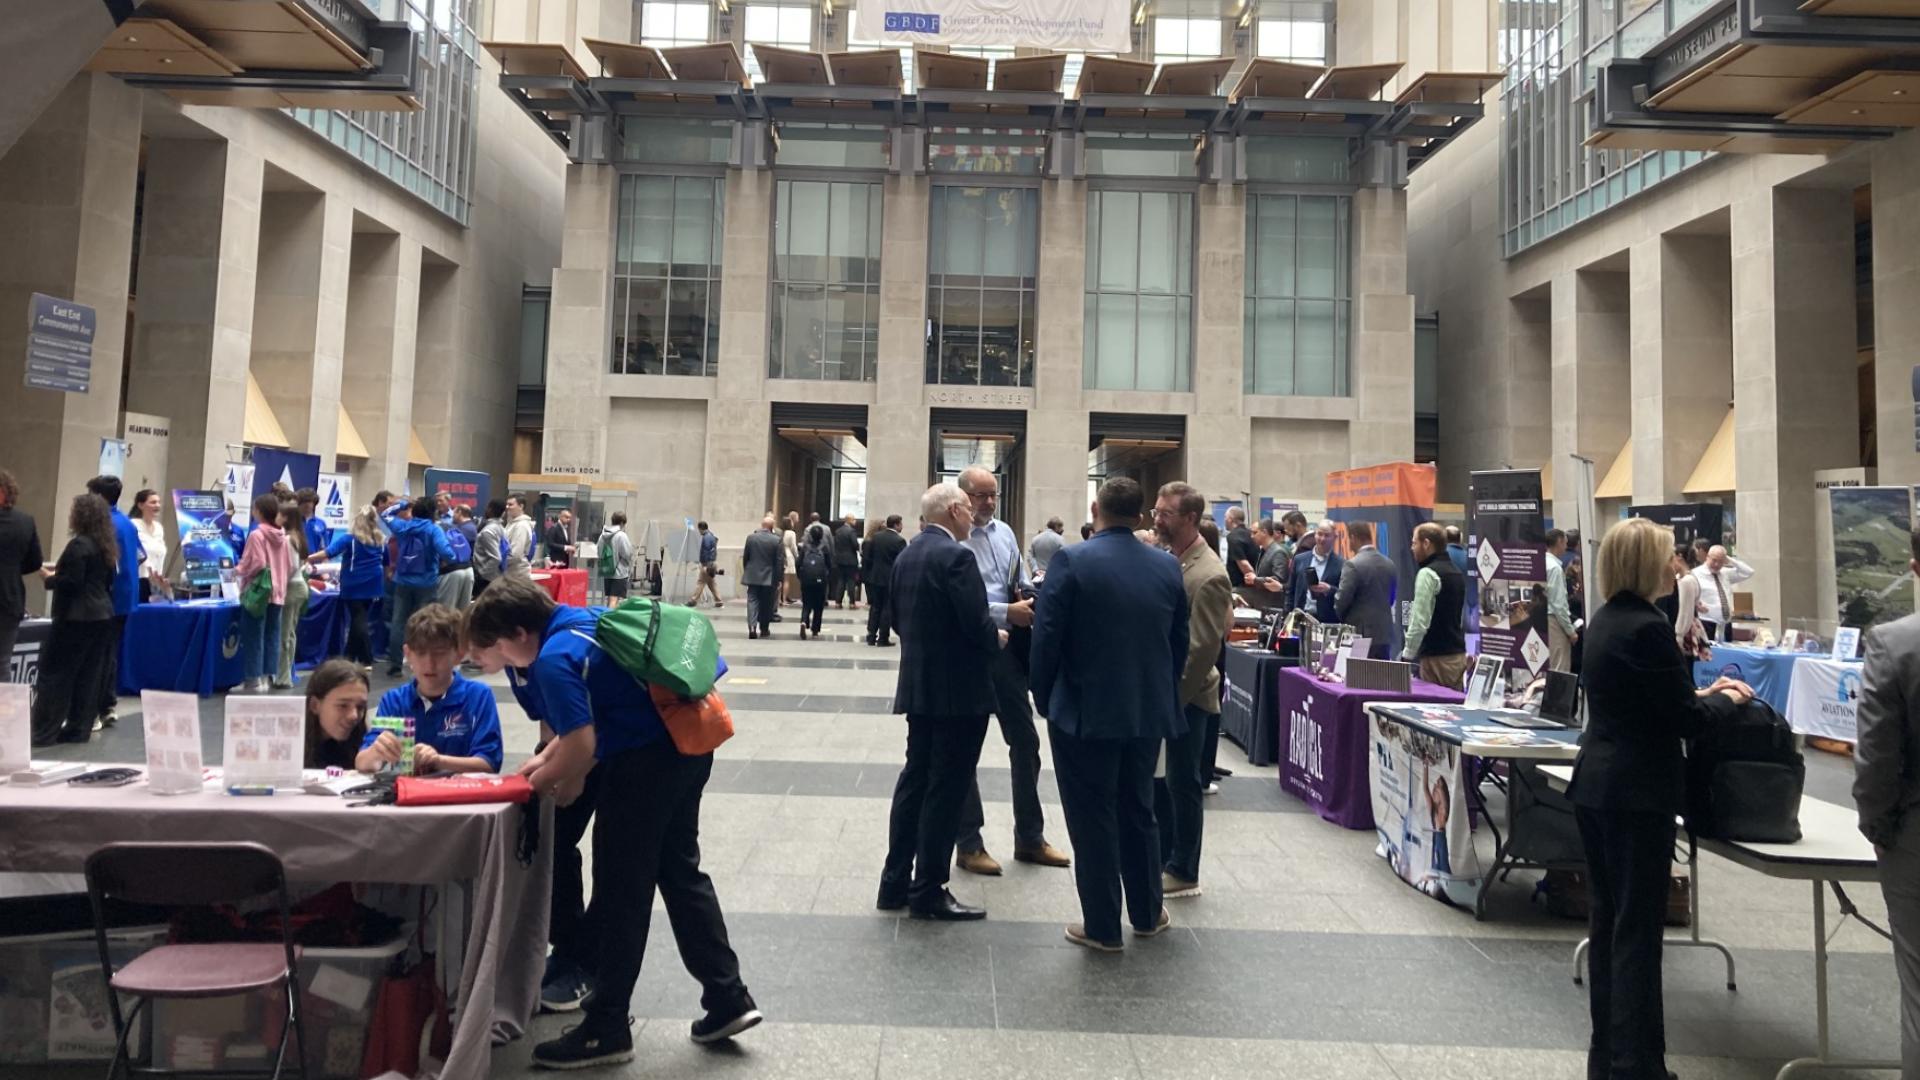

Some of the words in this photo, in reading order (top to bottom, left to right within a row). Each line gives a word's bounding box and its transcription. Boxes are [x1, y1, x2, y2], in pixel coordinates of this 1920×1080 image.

[886, 14, 939, 30] GBDF
[943, 15, 981, 27] Greater
[983, 16, 1011, 26] Berks
[1013, 17, 1076, 31] Development
[1078, 19, 1104, 30] Fund
[1669, 26, 1716, 65] MUSEUM
[929, 391, 975, 403] NORTH
[983, 393, 1030, 405] STREET
[129, 424, 152, 435] HEARING
[152, 428, 169, 437] ROOM
[544, 466, 576, 474] HEARING
[579, 467, 600, 475] ROOM
[1815, 480, 1841, 489] HEARING
[1842, 479, 1860, 487] ROOM
[1821, 703, 1855, 718] AVIATION
